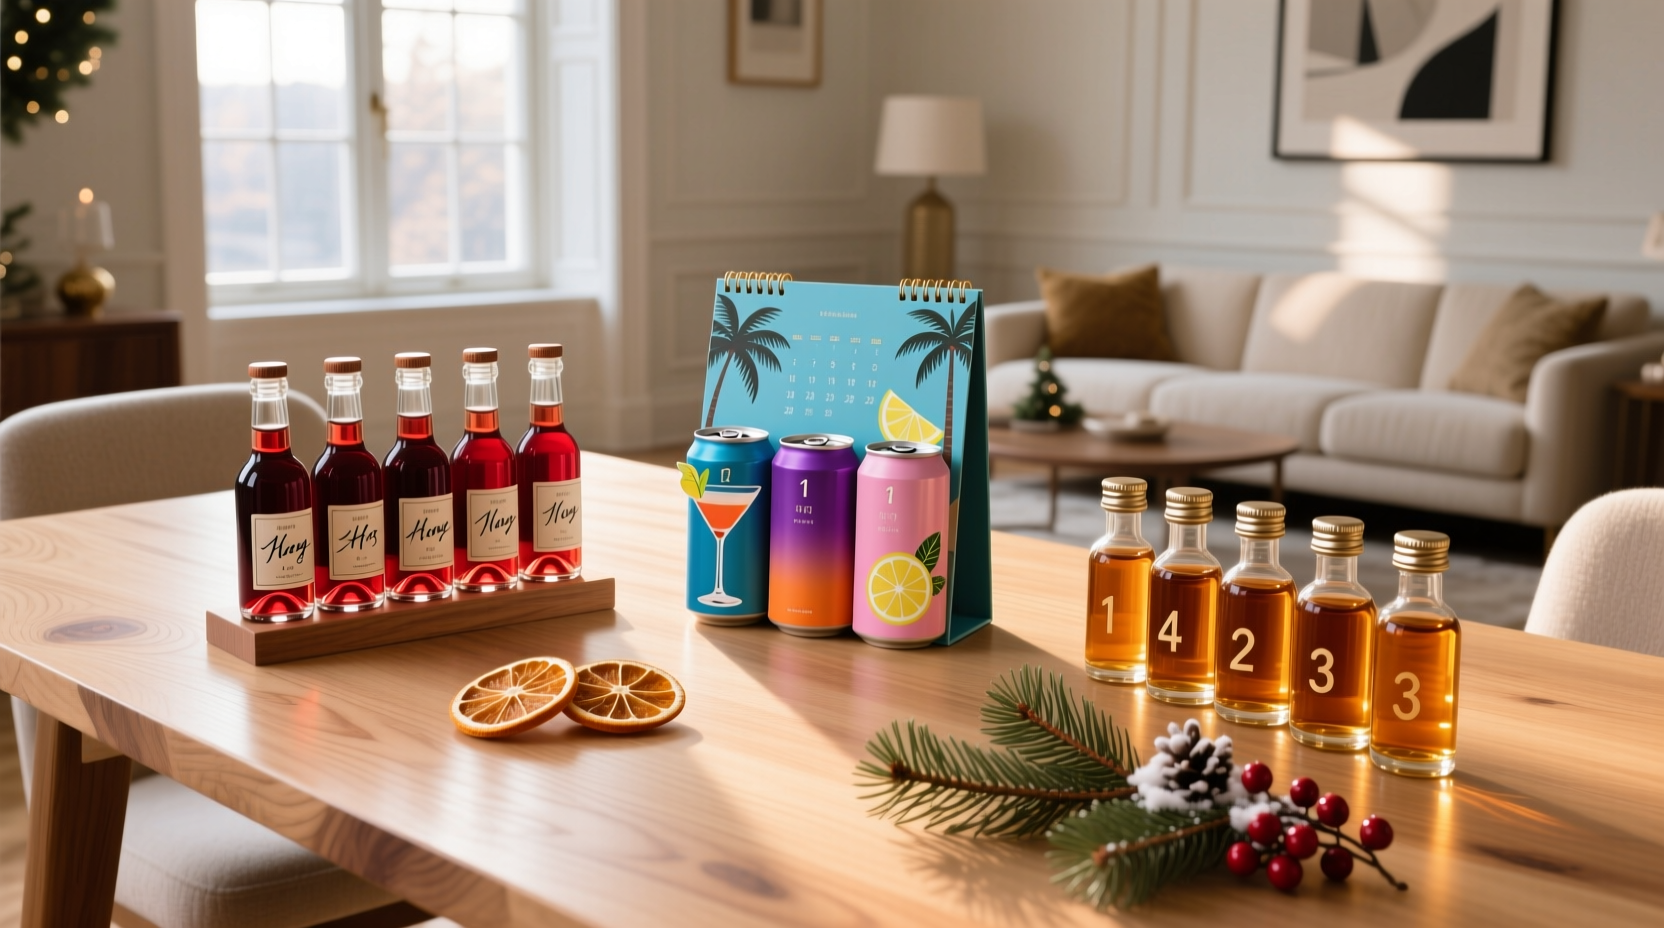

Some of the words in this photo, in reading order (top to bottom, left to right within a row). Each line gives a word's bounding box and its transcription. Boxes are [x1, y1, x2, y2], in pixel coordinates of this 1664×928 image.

[800, 479, 808, 498] 1
[885, 486, 894, 504] 1
[1101, 595, 1114, 634] 1
[1158, 610, 1182, 652] 4
[1229, 627, 1255, 672] 2
[1308, 648, 1335, 694] 3
[1392, 671, 1421, 721] 3
